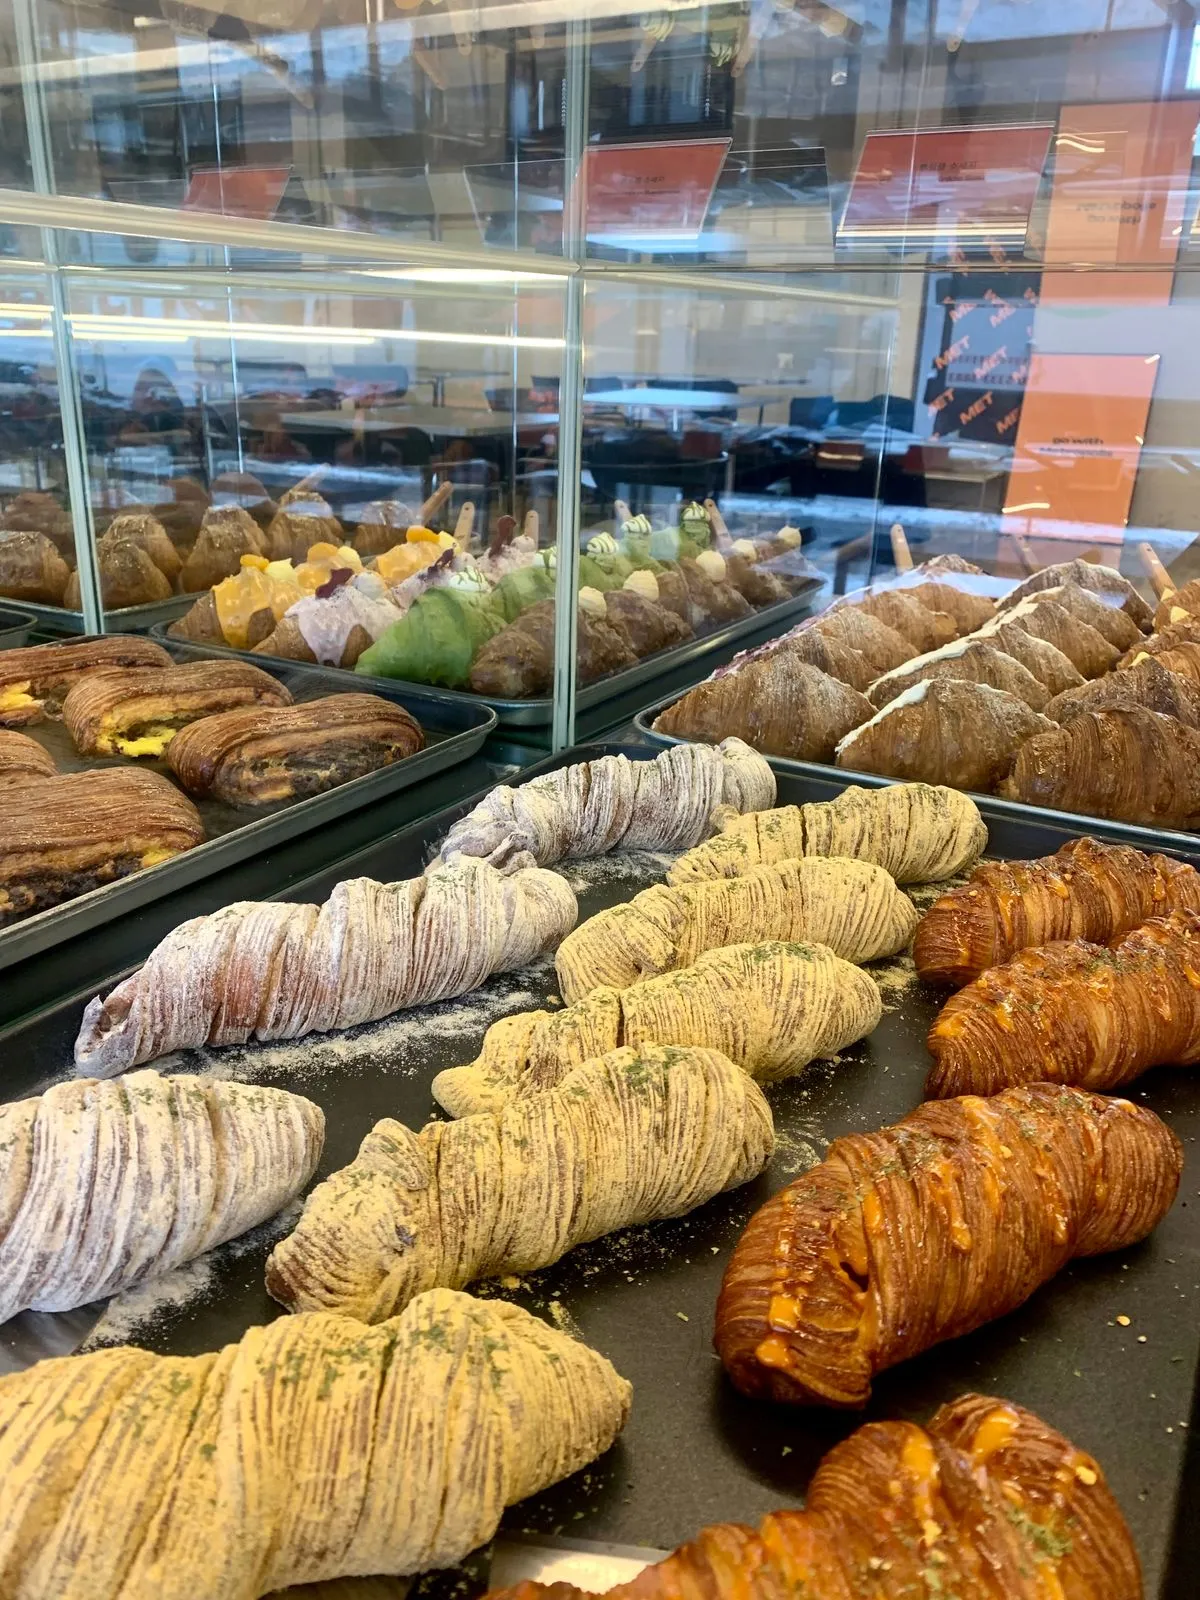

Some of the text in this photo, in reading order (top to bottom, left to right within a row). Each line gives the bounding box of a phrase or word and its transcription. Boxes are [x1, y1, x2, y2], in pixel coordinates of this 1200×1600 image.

[935, 335, 970, 369] MET
[974, 345, 1008, 378] MET
[960, 390, 993, 425] MET
[996, 406, 1020, 434] ME
